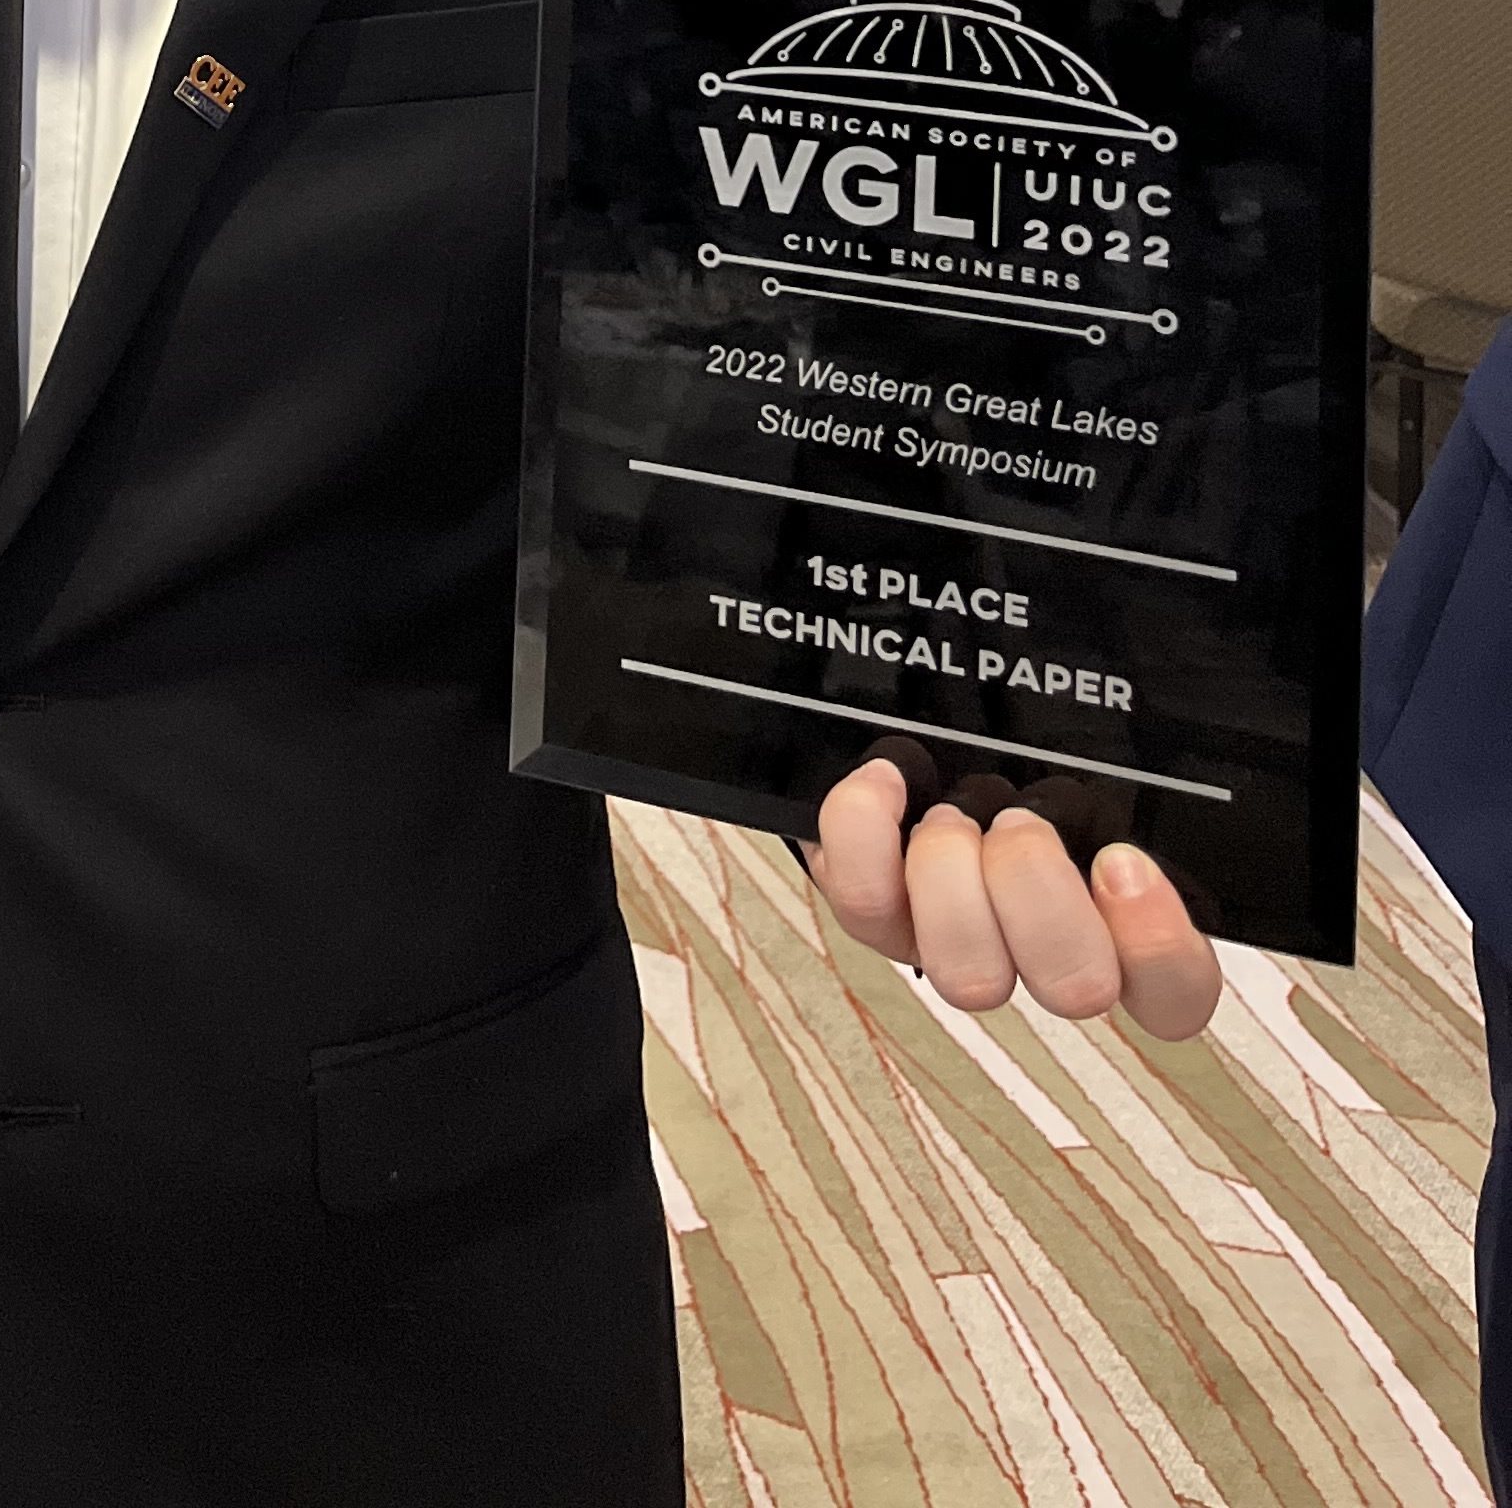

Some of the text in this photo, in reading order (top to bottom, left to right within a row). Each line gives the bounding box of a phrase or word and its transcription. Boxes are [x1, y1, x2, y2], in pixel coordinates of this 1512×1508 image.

[189, 54, 246, 113] CEE
[738, 105, 1136, 167] AMERICAN SOCIETY OF
[698, 126, 974, 239] WGL
[1025, 169, 1171, 216] UIUC
[784, 234, 1080, 290] CIVIL ENGINEERS
[1023, 219, 1169, 268] 2022
[706, 345, 1159, 445] 2022 Western Great Lakes
[758, 404, 1096, 489] Student Symposium
[807, 556, 1029, 627] 1st PLACE
[709, 595, 1132, 711] TECHNICAL PAPER
